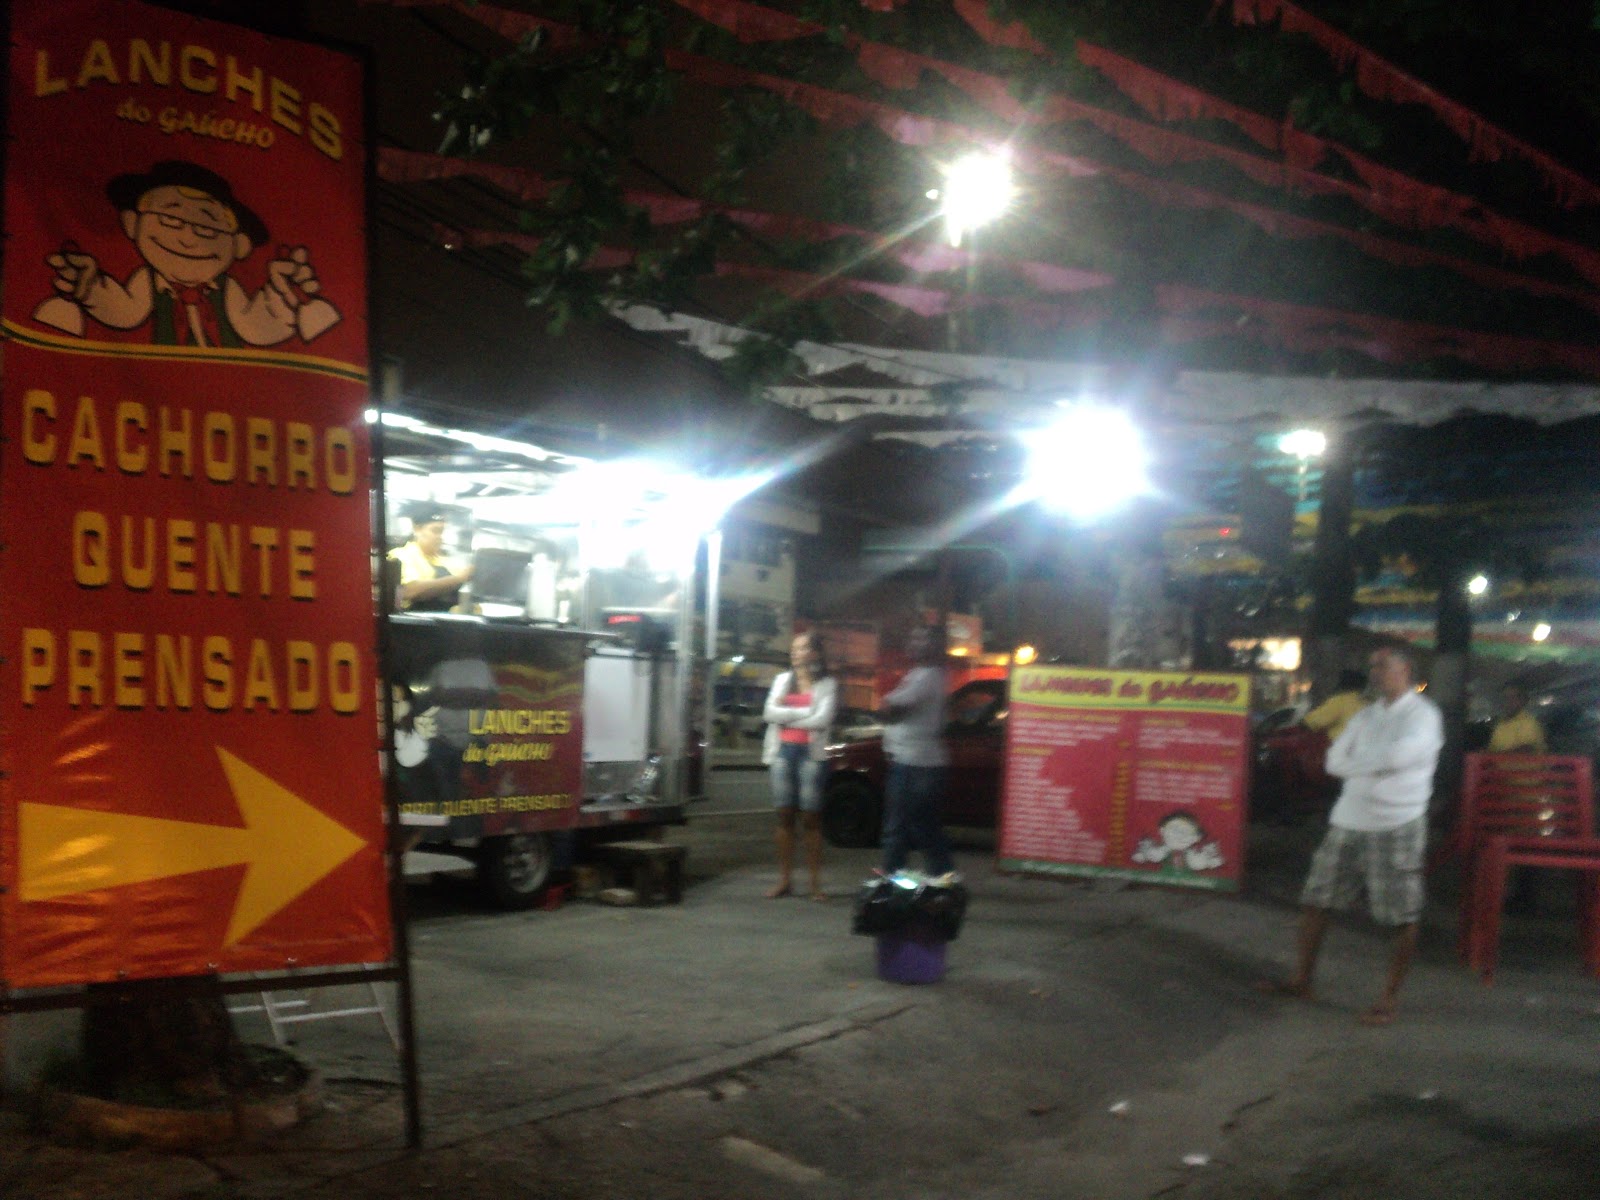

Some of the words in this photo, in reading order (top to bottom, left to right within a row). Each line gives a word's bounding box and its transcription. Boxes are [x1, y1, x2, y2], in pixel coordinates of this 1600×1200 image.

[34, 38, 343, 161] LANCHES
[116, 97, 151, 125] do
[22, 389, 357, 495] CACHORRO
[72, 510, 317, 601] QUENTE
[22, 627, 361, 714] PRENSADO
[468, 709, 572, 735] LANCHES
